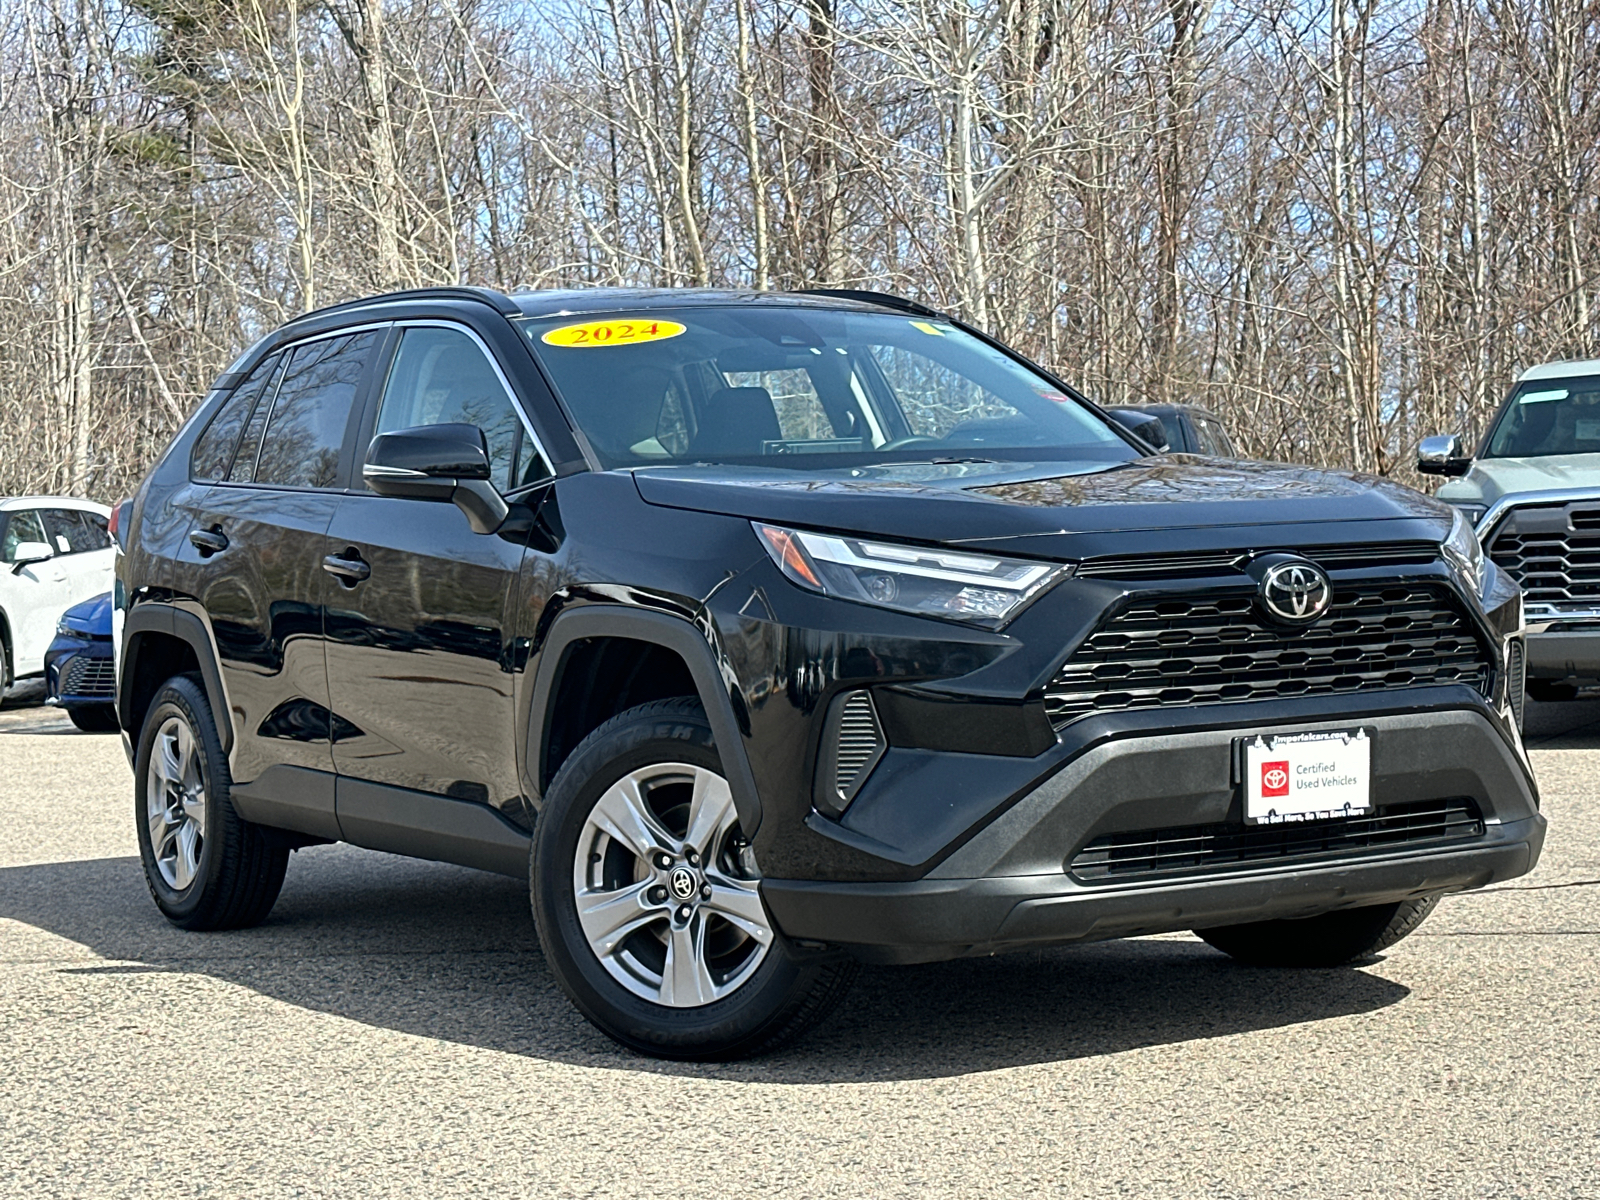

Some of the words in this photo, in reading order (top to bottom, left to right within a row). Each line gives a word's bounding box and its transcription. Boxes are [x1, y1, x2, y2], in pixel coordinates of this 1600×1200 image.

[571, 322, 660, 345] 2024
[1296, 762, 1336, 775] Certified
[1296, 778, 1319, 790] Used
[1321, 775, 1357, 788] Vehicles
[1257, 816, 1269, 825] We
